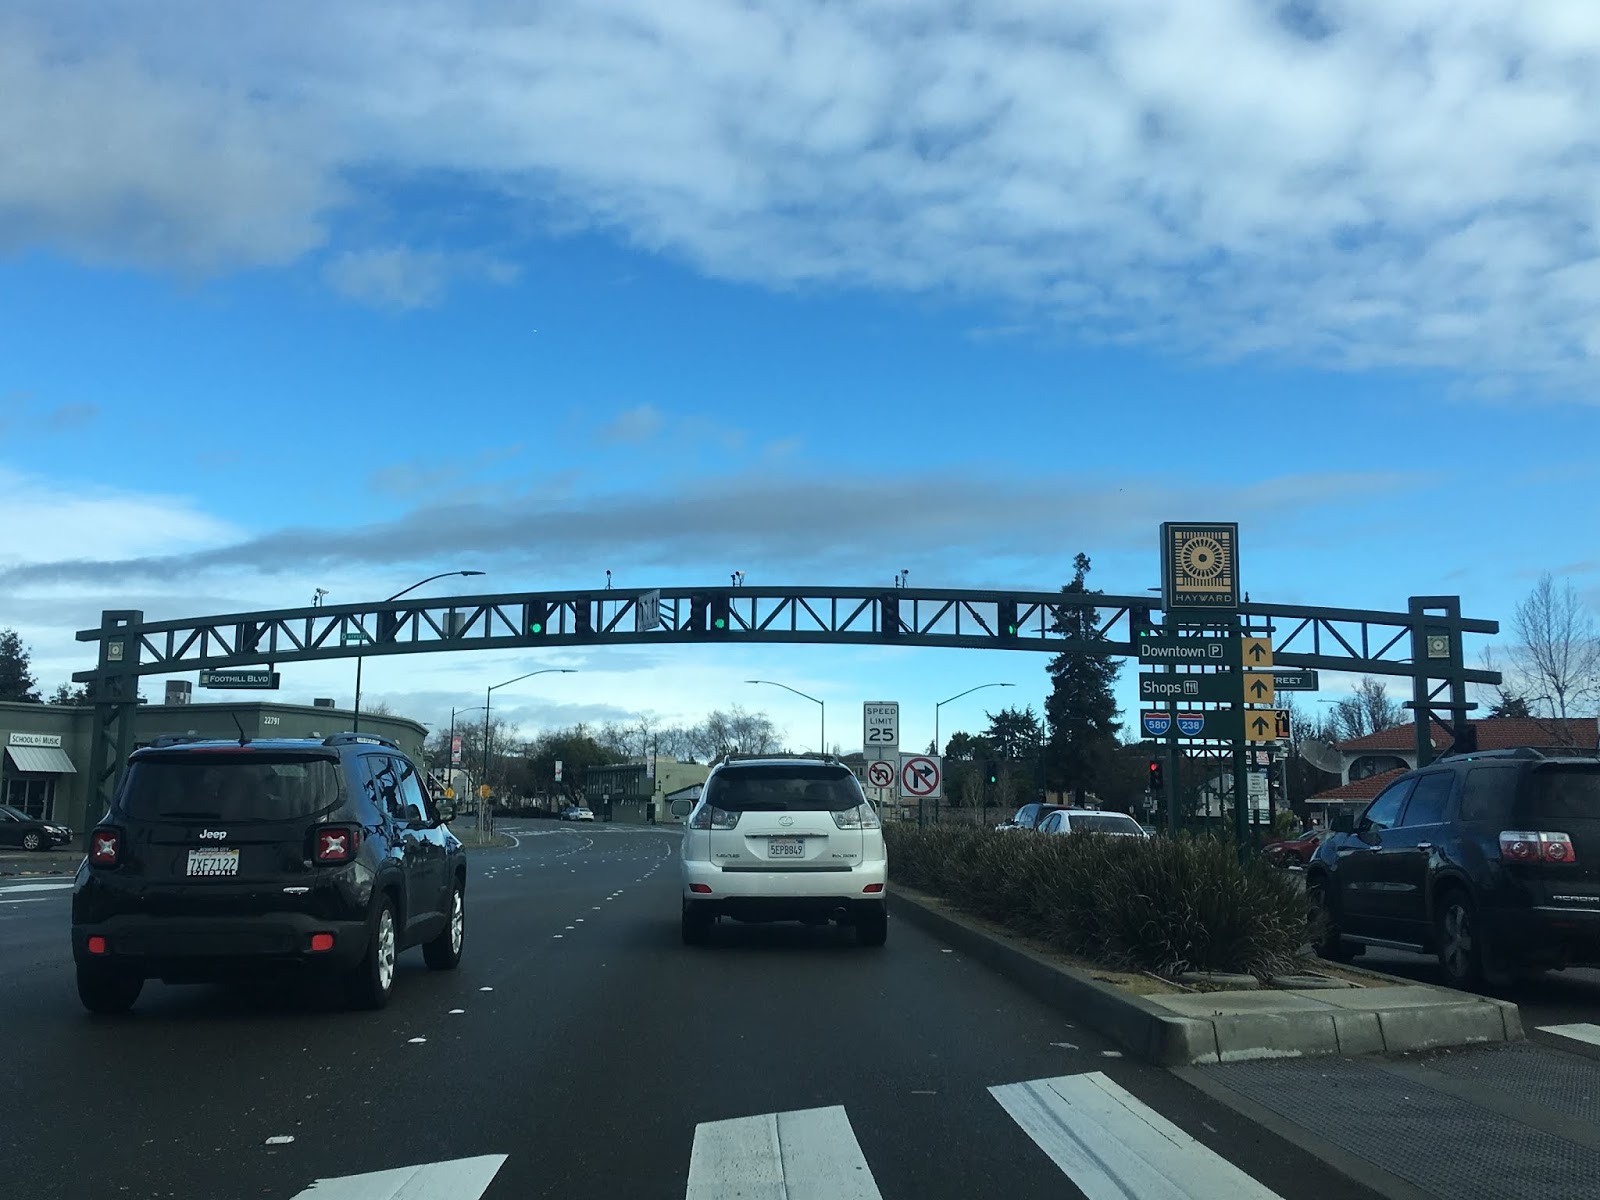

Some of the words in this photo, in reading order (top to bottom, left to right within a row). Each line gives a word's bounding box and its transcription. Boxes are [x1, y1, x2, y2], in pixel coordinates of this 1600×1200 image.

[1175, 594, 1232, 602] HAYWARD
[1141, 644, 1206, 657] Downtown
[209, 675, 246, 683] FOOTHILL
[247, 675, 269, 683] BLVD
[1143, 681, 1182, 697] Shops
[866, 707, 896, 715] SPEED
[1274, 711, 1288, 720] CA
[264, 716, 280, 725] 22791
[1148, 720, 1168, 729] 580
[1181, 721, 1200, 730] 238
[869, 727, 894, 742] 25
[12, 735, 34, 744] SCHOOL
[43, 736, 59, 745] MUSIC
[199, 829, 227, 840] Jeep
[770, 845, 803, 856] 5EPB849
[190, 858, 237, 872] 7XFZ122
